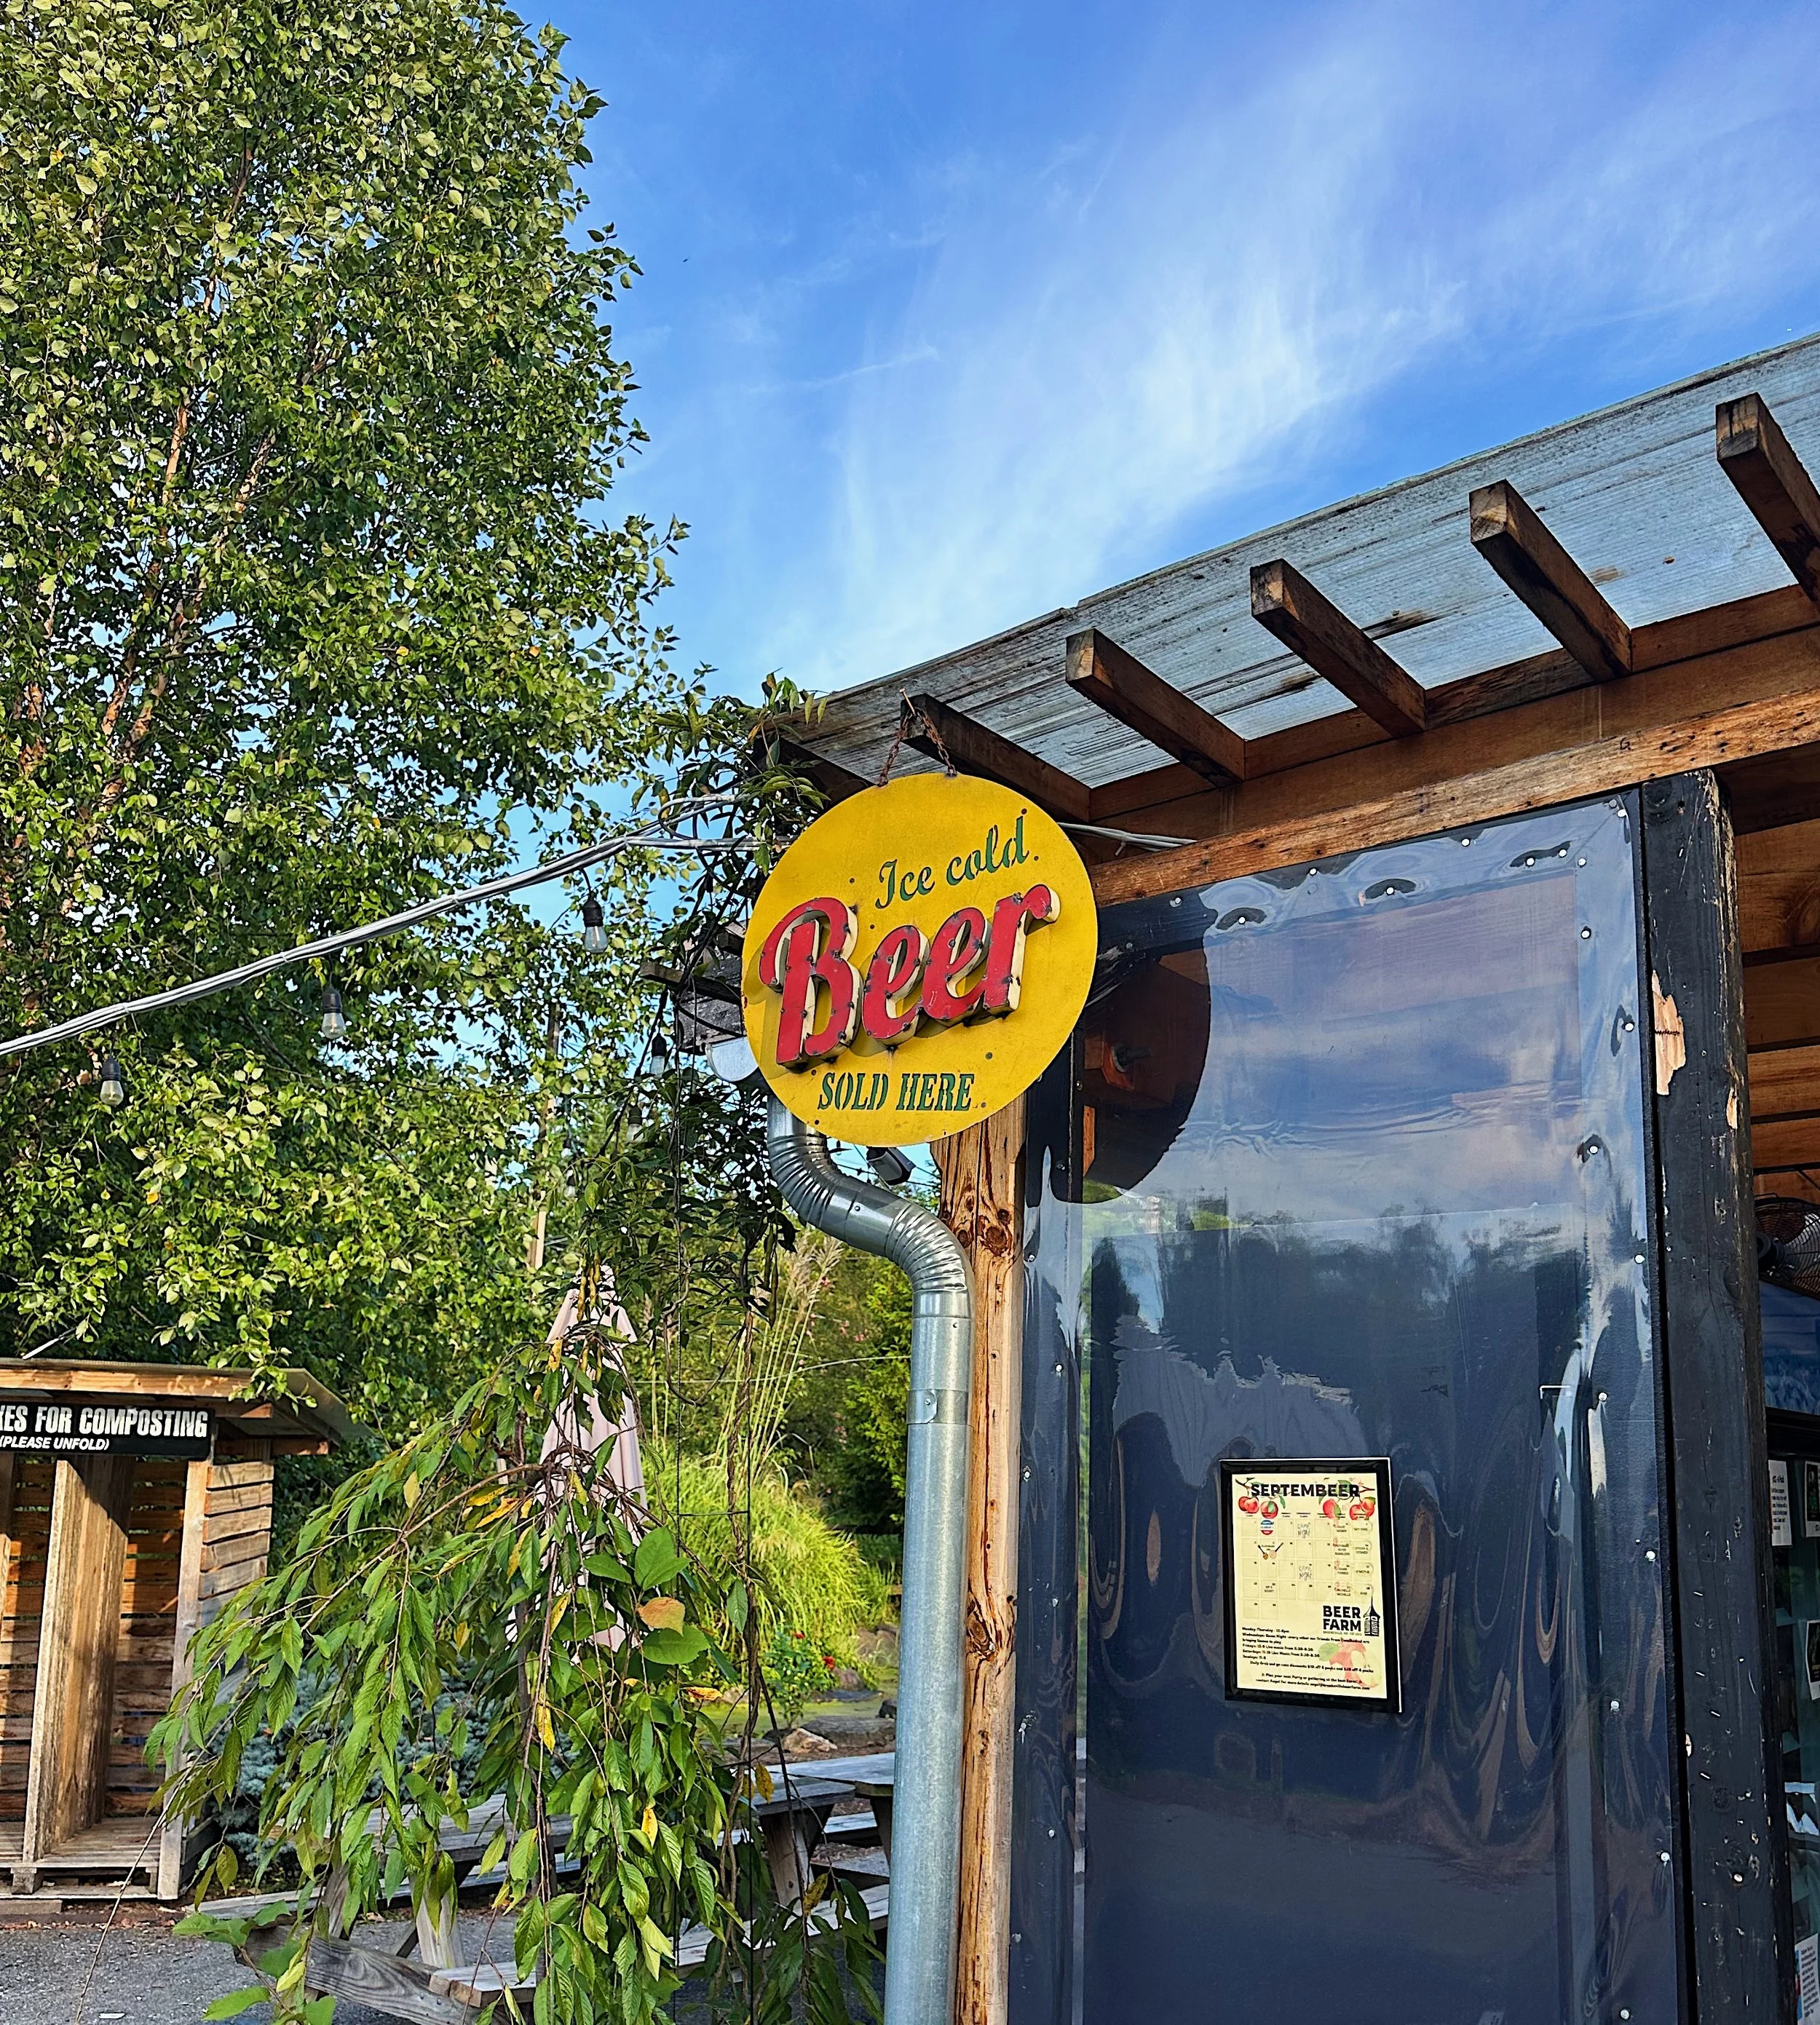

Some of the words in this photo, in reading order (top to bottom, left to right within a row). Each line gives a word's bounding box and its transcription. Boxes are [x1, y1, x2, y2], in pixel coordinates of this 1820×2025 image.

[874, 859, 935, 909] Ice
[946, 815, 1030, 887] cold
[759, 884, 1061, 1071] Beer
[818, 1072, 889, 1111] SOLD
[895, 1072, 975, 1111] HERE
[35, 1406, 72, 1434] FOR
[79, 1407, 208, 1438] COMPOSTING
[53, 1437, 109, 1451] UNFOLD)
[1251, 1483, 1361, 1498] SEPTEMBEER
[1323, 1605, 1361, 1619] BEER
[1323, 1618, 1361, 1632] FARM
